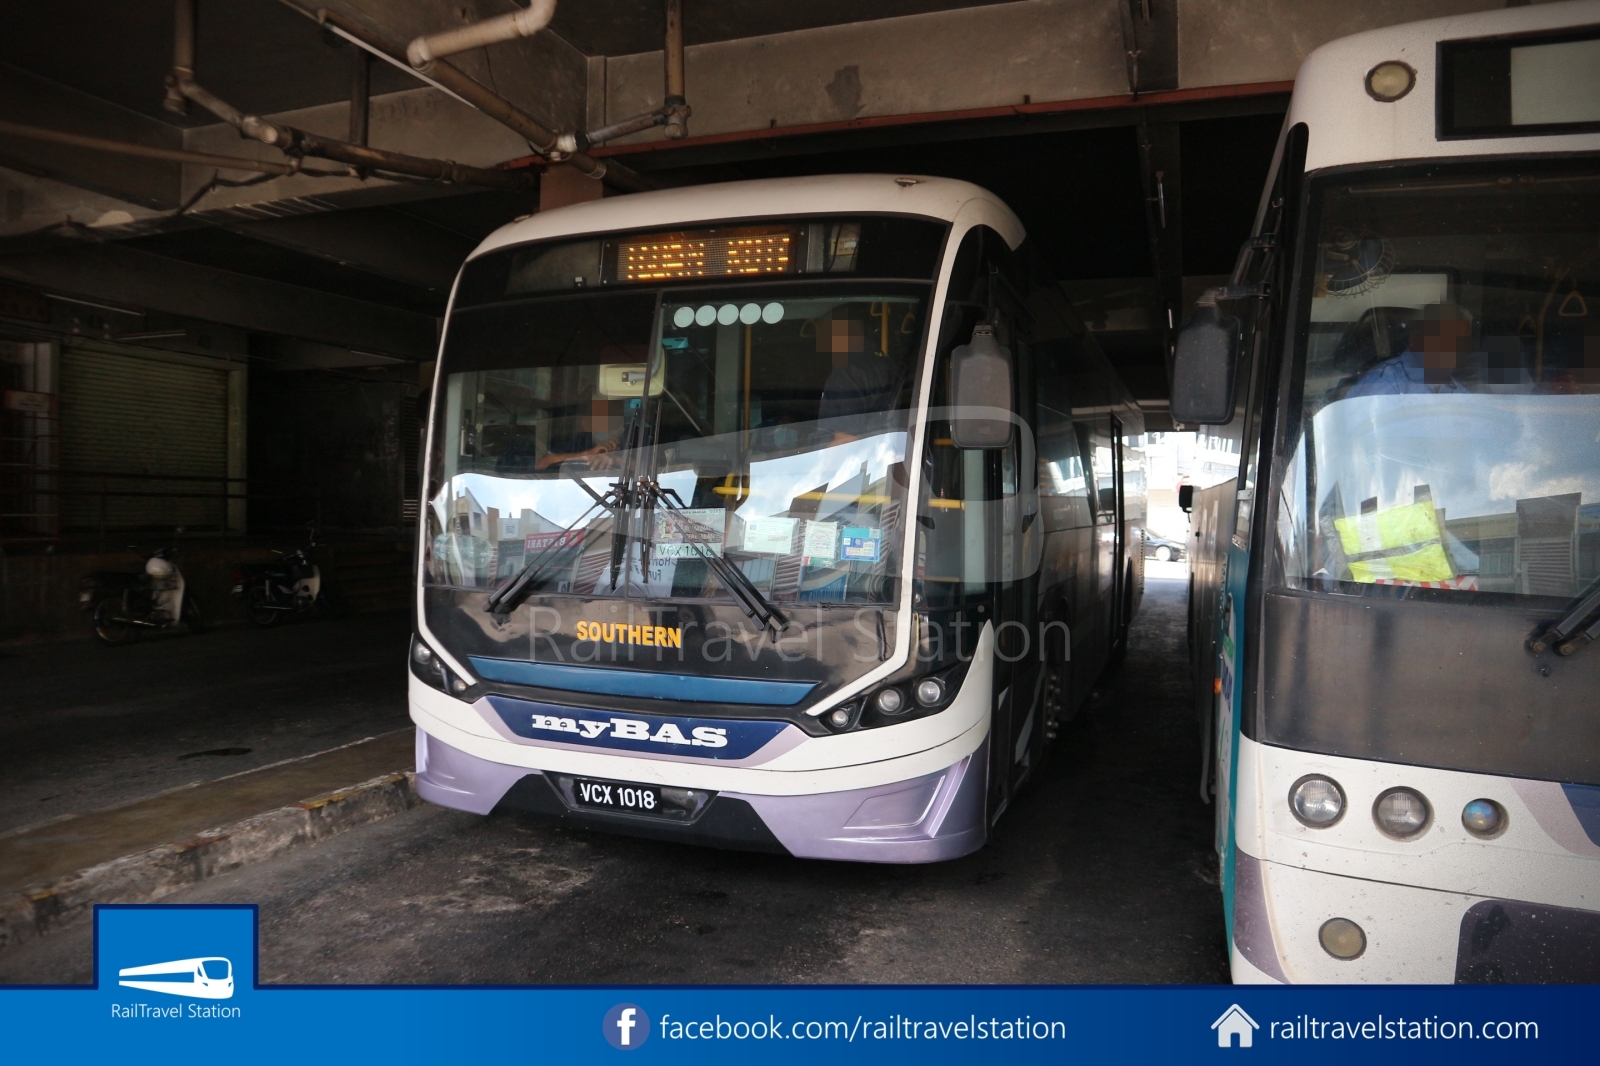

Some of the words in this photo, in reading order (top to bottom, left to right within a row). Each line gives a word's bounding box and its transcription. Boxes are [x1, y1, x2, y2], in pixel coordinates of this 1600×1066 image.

[659, 545, 682, 557] VCX
[576, 620, 682, 649] SOUTHERN
[531, 714, 729, 749] myBAS
[580, 783, 613, 804] VCX
[617, 787, 655, 809] 1018
